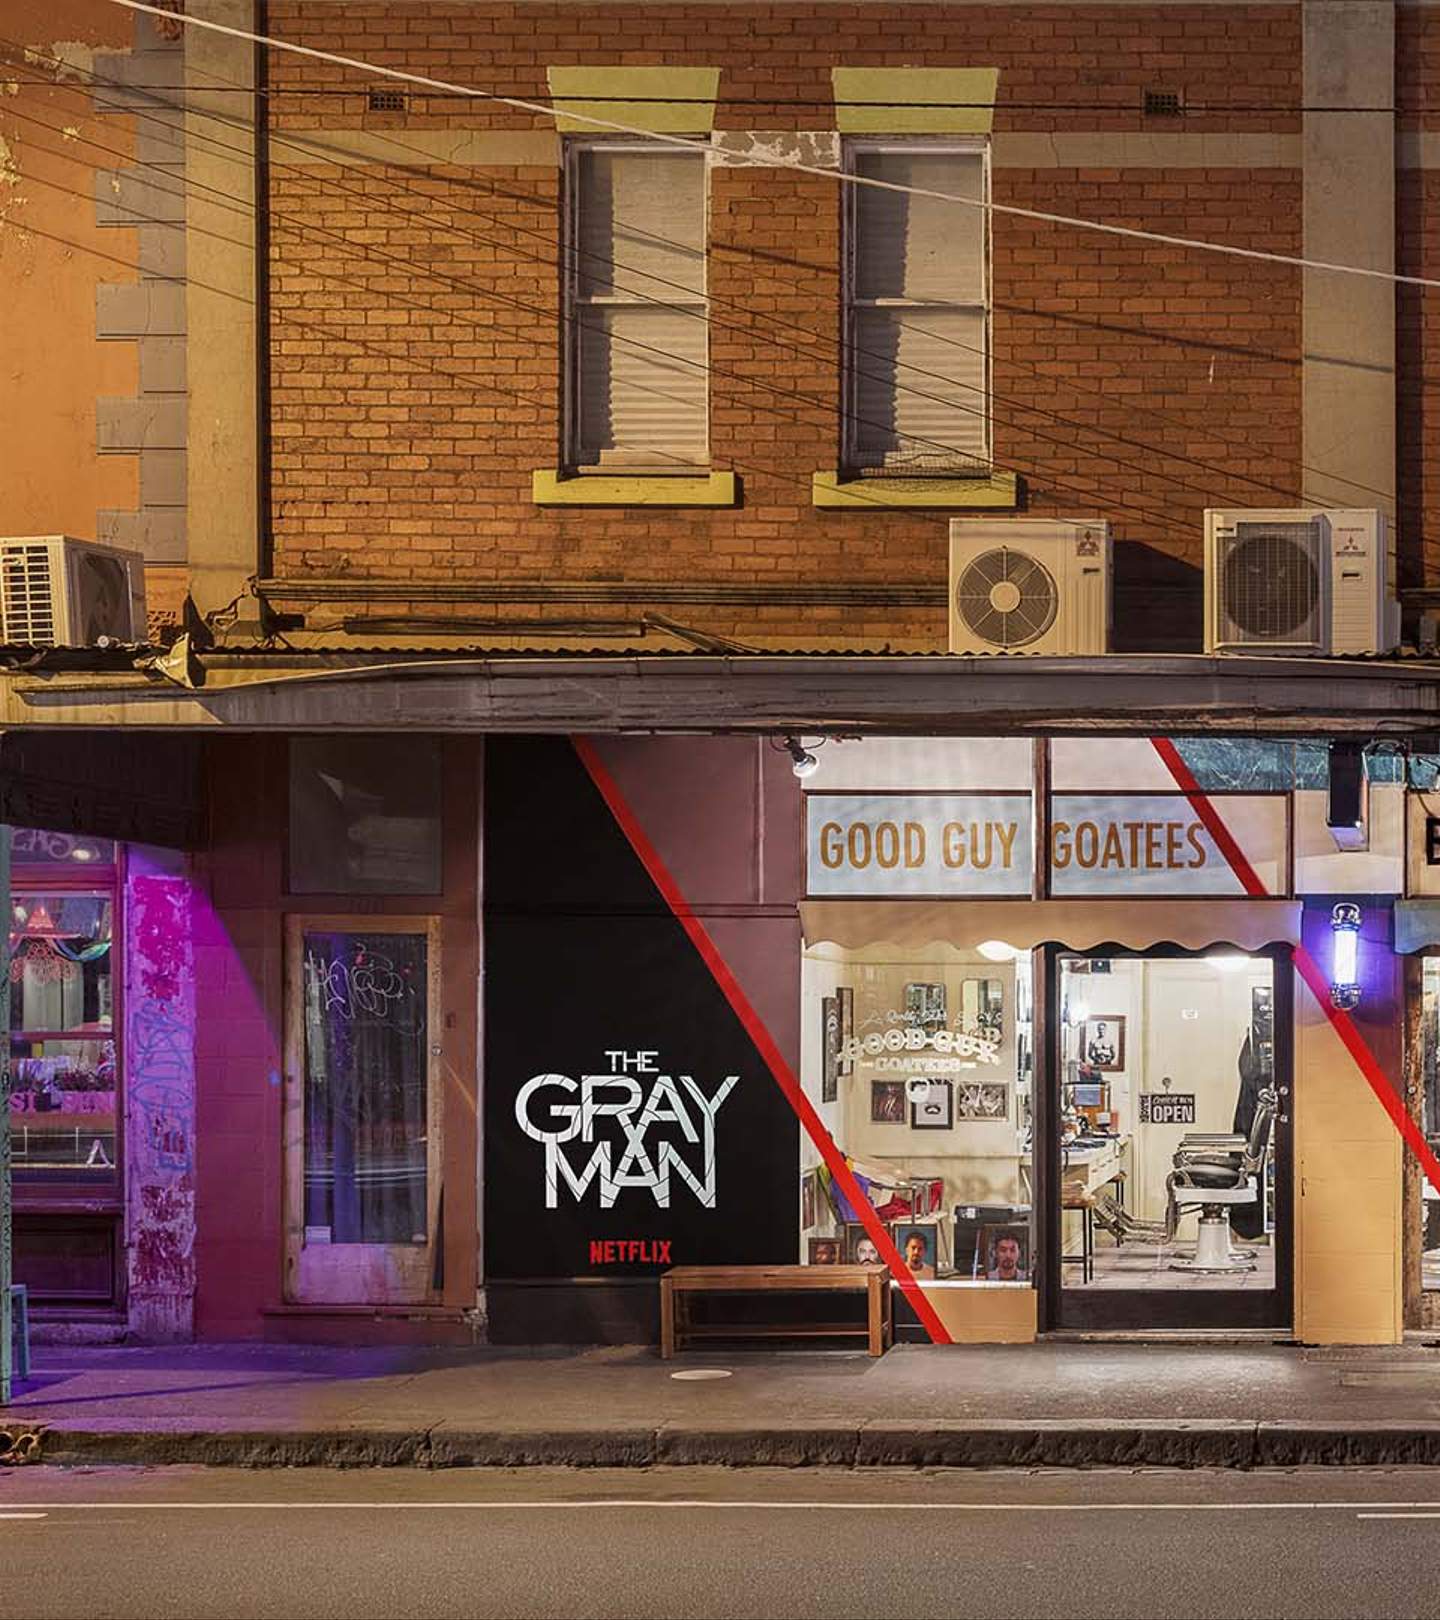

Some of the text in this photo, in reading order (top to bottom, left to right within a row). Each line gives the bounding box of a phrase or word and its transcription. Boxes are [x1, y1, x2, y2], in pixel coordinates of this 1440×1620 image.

[819, 821, 1208, 870] GOOD GUY GOATEES
[604, 1051, 660, 1073] THE
[514, 1073, 740, 1143] GRAY
[1152, 1105, 1194, 1123] OPEN
[545, 1140, 717, 1209] MAN
[589, 1240, 672, 1264] NETFLIX
